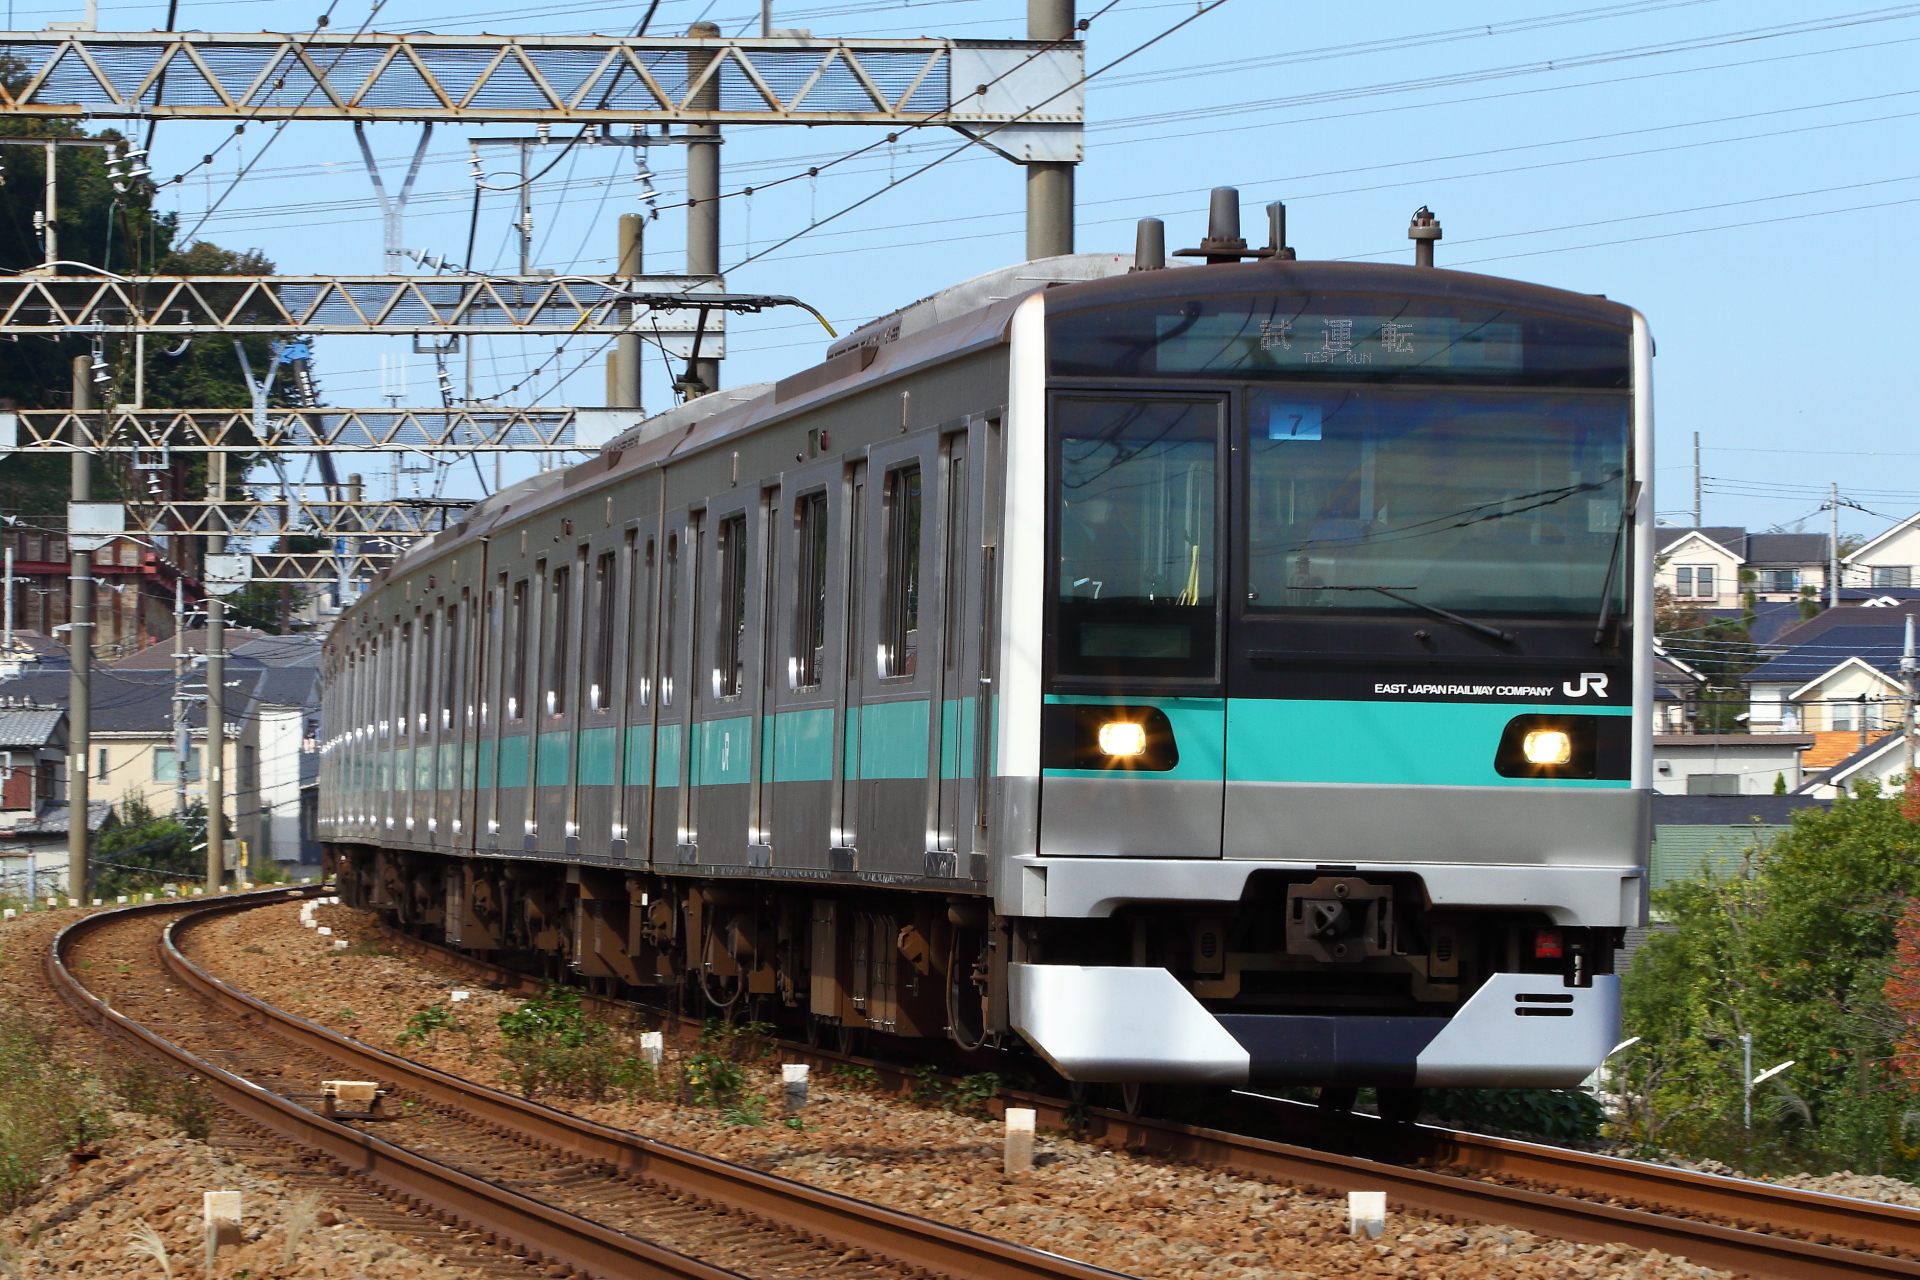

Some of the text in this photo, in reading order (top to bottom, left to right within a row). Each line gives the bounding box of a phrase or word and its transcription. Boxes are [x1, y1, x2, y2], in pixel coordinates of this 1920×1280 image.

[1260, 318, 1415, 353] 試運転
[1303, 352, 1372, 365] TEST RUN
[1288, 414, 1304, 436] 7
[1092, 581, 1103, 600] 7
[1374, 683, 1554, 697] EAST JAPAN RAILWAY COMPANY
[1562, 672, 1609, 698] JR
[721, 732, 730, 772] JR
